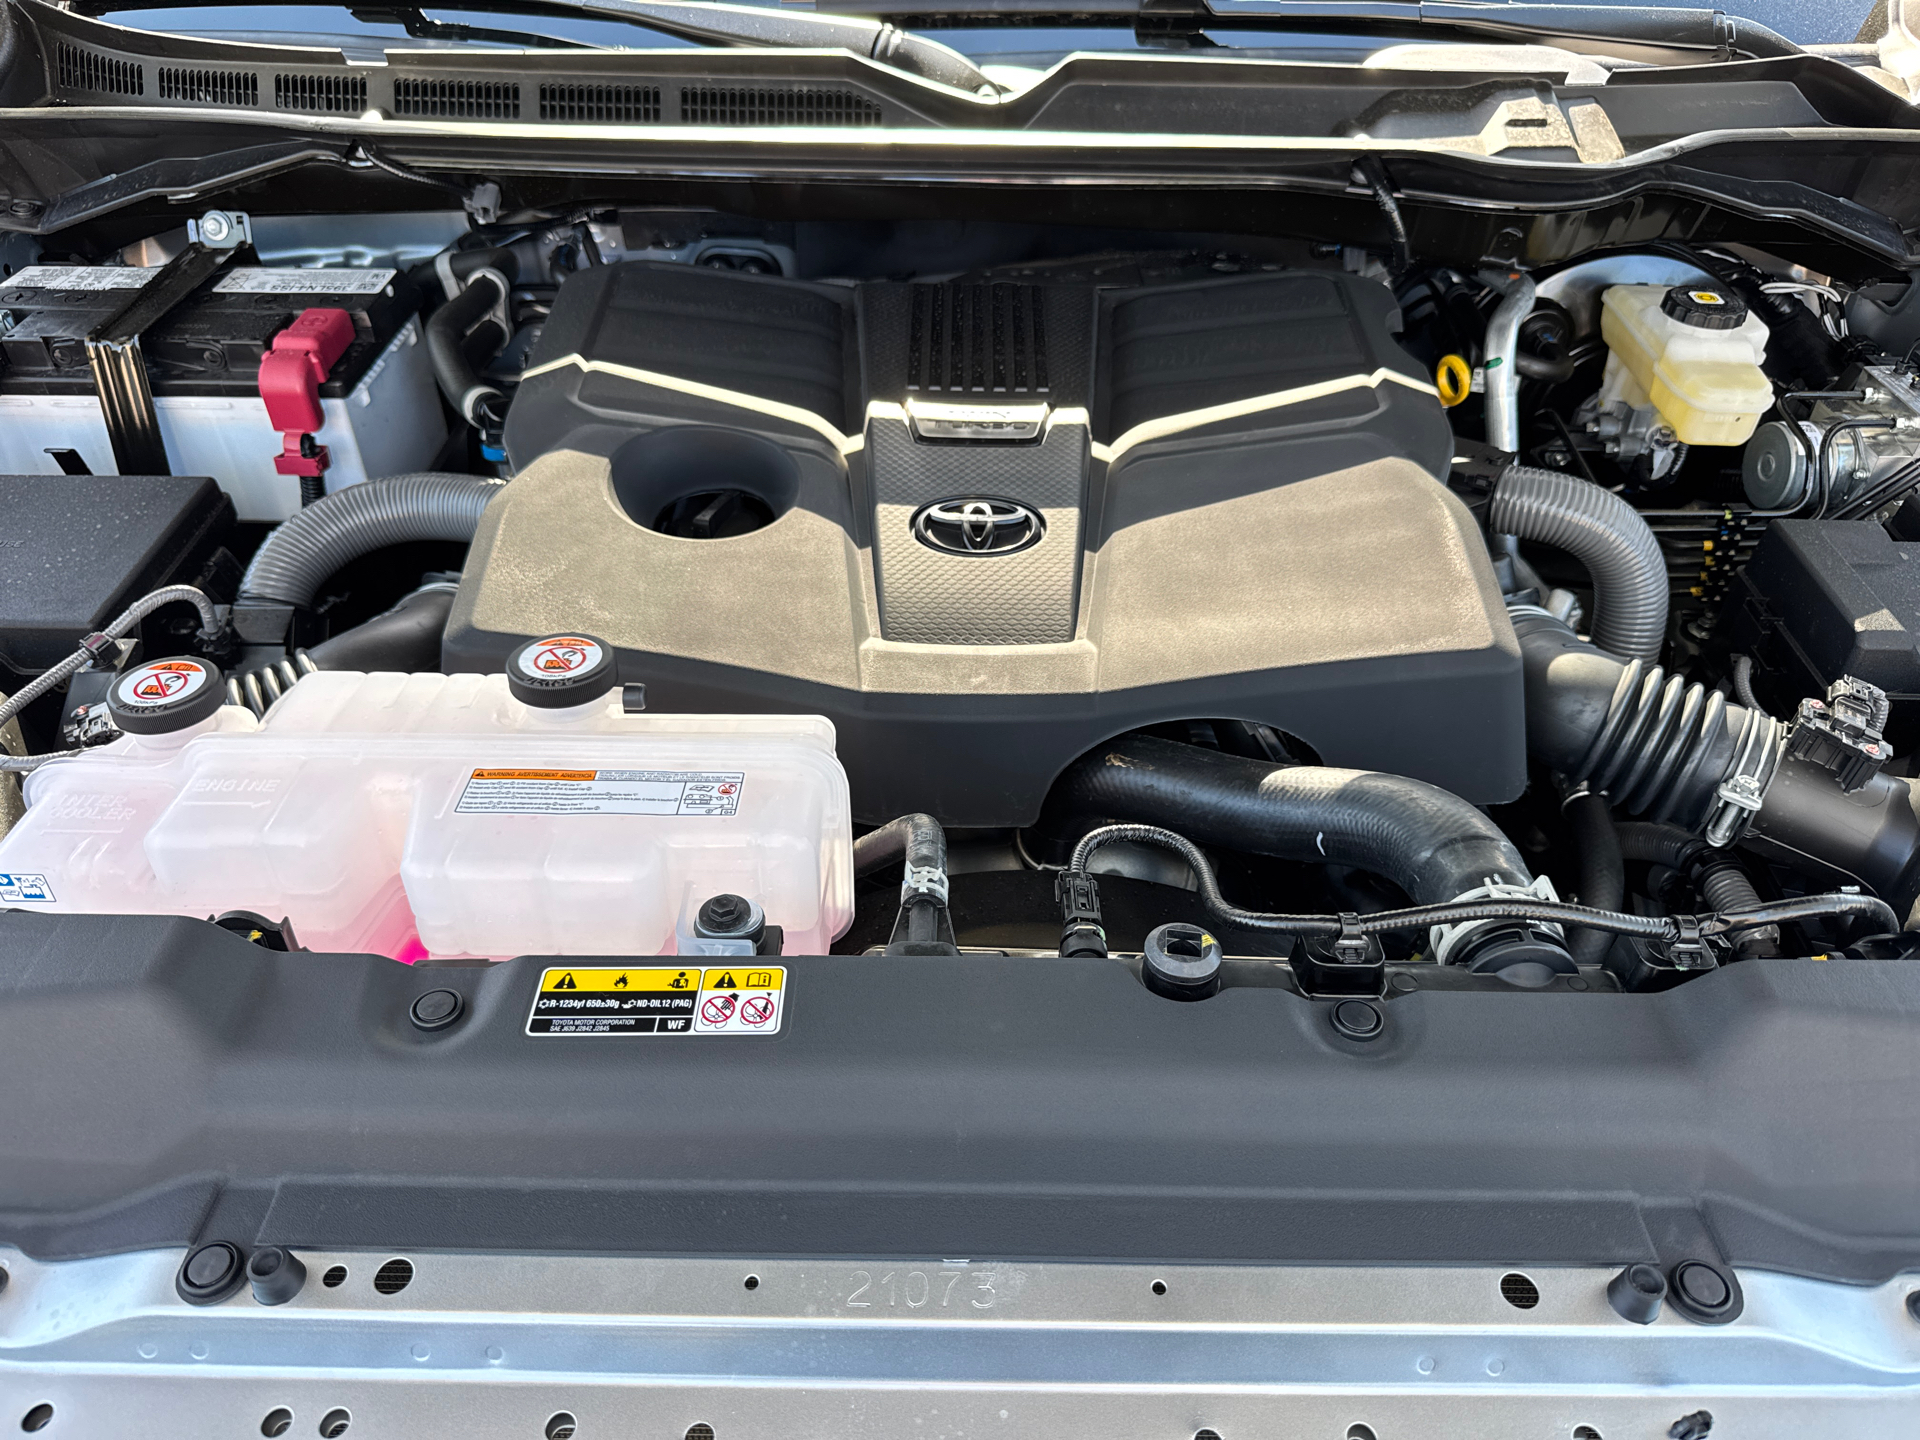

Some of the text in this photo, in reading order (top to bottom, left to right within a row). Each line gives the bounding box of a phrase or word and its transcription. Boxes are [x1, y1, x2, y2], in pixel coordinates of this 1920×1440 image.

[191, 778, 281, 793] ENGINE
[50, 807, 136, 821] COOLER
[549, 999, 585, 1008] R-1234yf
[636, 999, 671, 1008] ND-OIL12
[671, 999, 692, 1009] (PAG)
[595, 1018, 635, 1026] CORPORATION
[667, 1019, 685, 1030] WF
[846, 1270, 997, 1309] 21073
